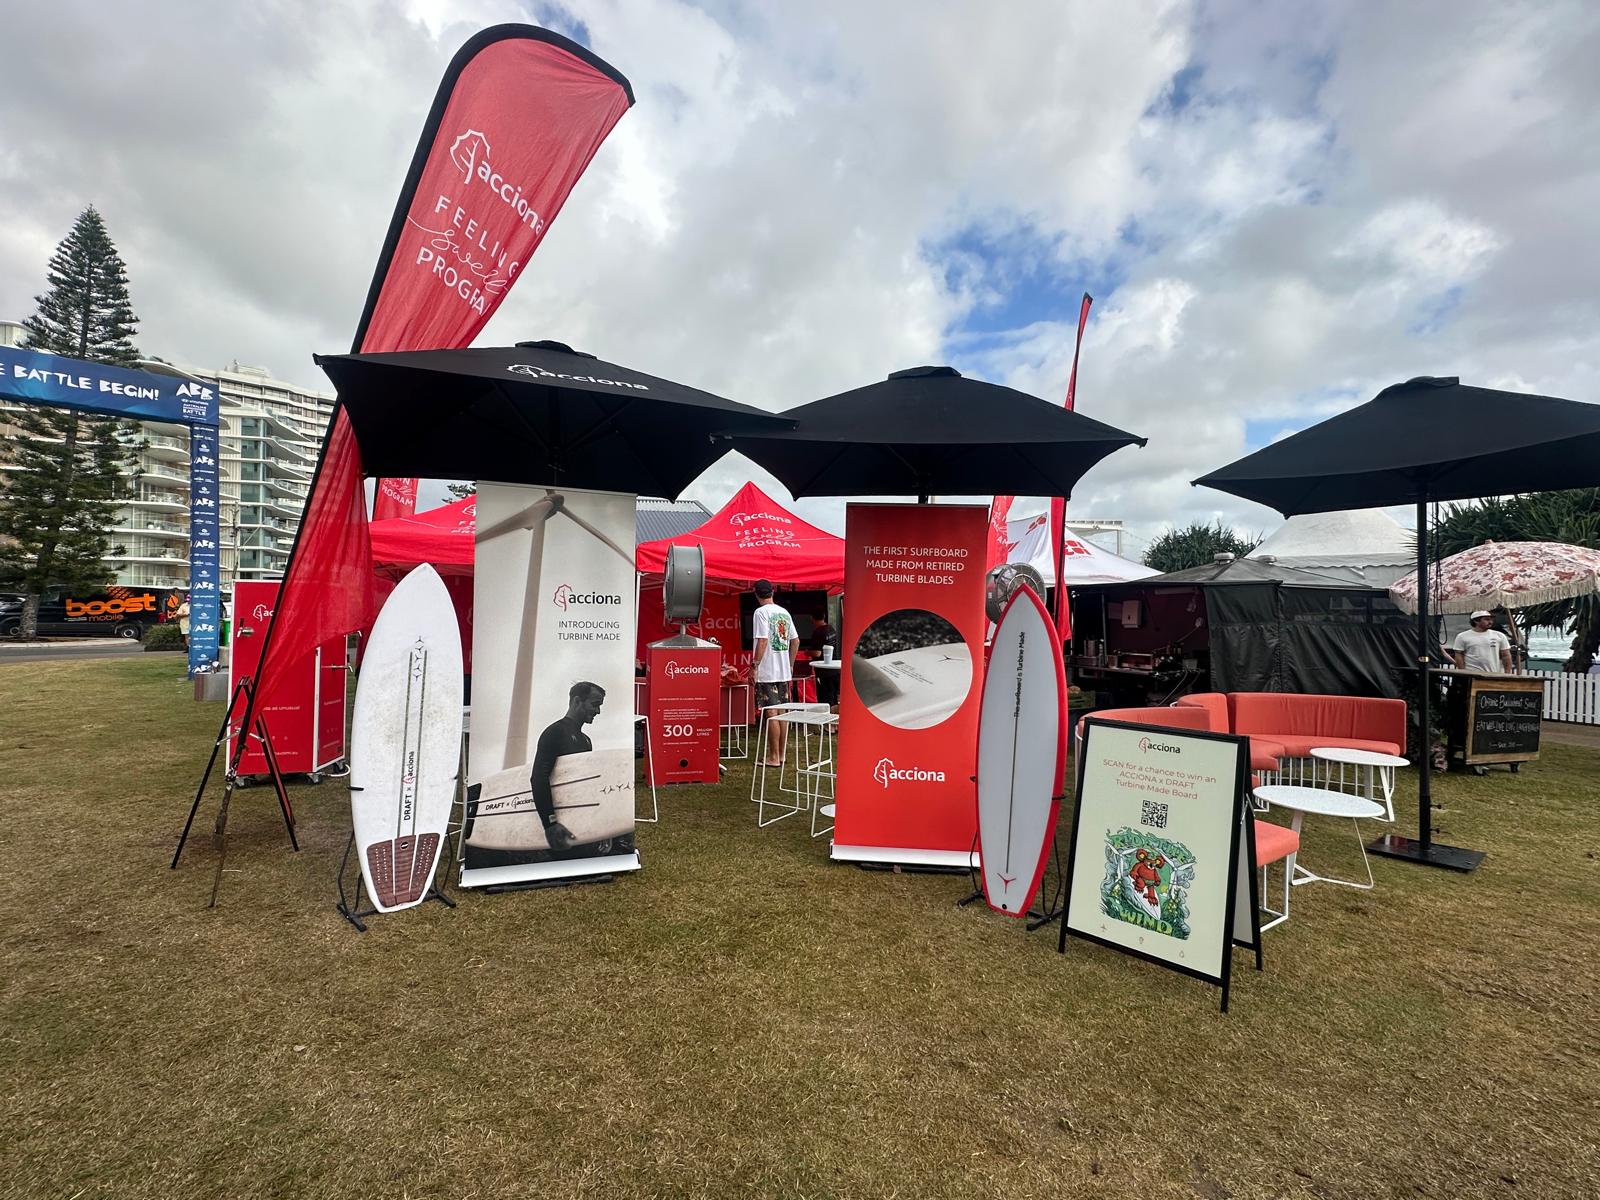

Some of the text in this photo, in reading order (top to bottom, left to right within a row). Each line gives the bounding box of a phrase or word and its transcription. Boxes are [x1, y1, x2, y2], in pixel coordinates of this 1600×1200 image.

[477, 160, 544, 234] acciona
[14, 364, 91, 390] BATTLE
[100, 379, 159, 401] BEGIN!
[540, 371, 649, 391] acciona
[744, 512, 792, 525] acciona
[736, 526, 795, 537] FEELING
[739, 539, 801, 549] PROGRAM
[864, 546, 968, 558] THE FIRST SURFBOARD
[866, 560, 965, 572] MADE FROM RETIRED
[876, 573, 954, 585] TURBINE BLADES
[568, 591, 622, 605] acciona
[66, 593, 157, 617] boost
[88, 614, 124, 622] mobile
[558, 620, 620, 629] INTRODUCING
[558, 632, 621, 641] TURBINE MADE
[674, 664, 709, 674] acciona
[663, 724, 693, 738] 300
[1147, 743, 1181, 754] acciona
[407, 750, 415, 776] acciona
[889, 766, 945, 782] acciona
[1103, 759, 1125, 769] SCAN
[1126, 761, 1136, 770] for
[1144, 764, 1175, 777] chance
[1177, 771, 1185, 779] to
[1187, 773, 1203, 782] win
[1205, 776, 1217, 784] an
[1119, 771, 1157, 784] ACCIONA
[1165, 778, 1195, 789] DRAFT
[1116, 779, 1198, 800] Turbine Made Board
[403, 794, 412, 820] DRAFT
[486, 801, 505, 811] DRAFT
